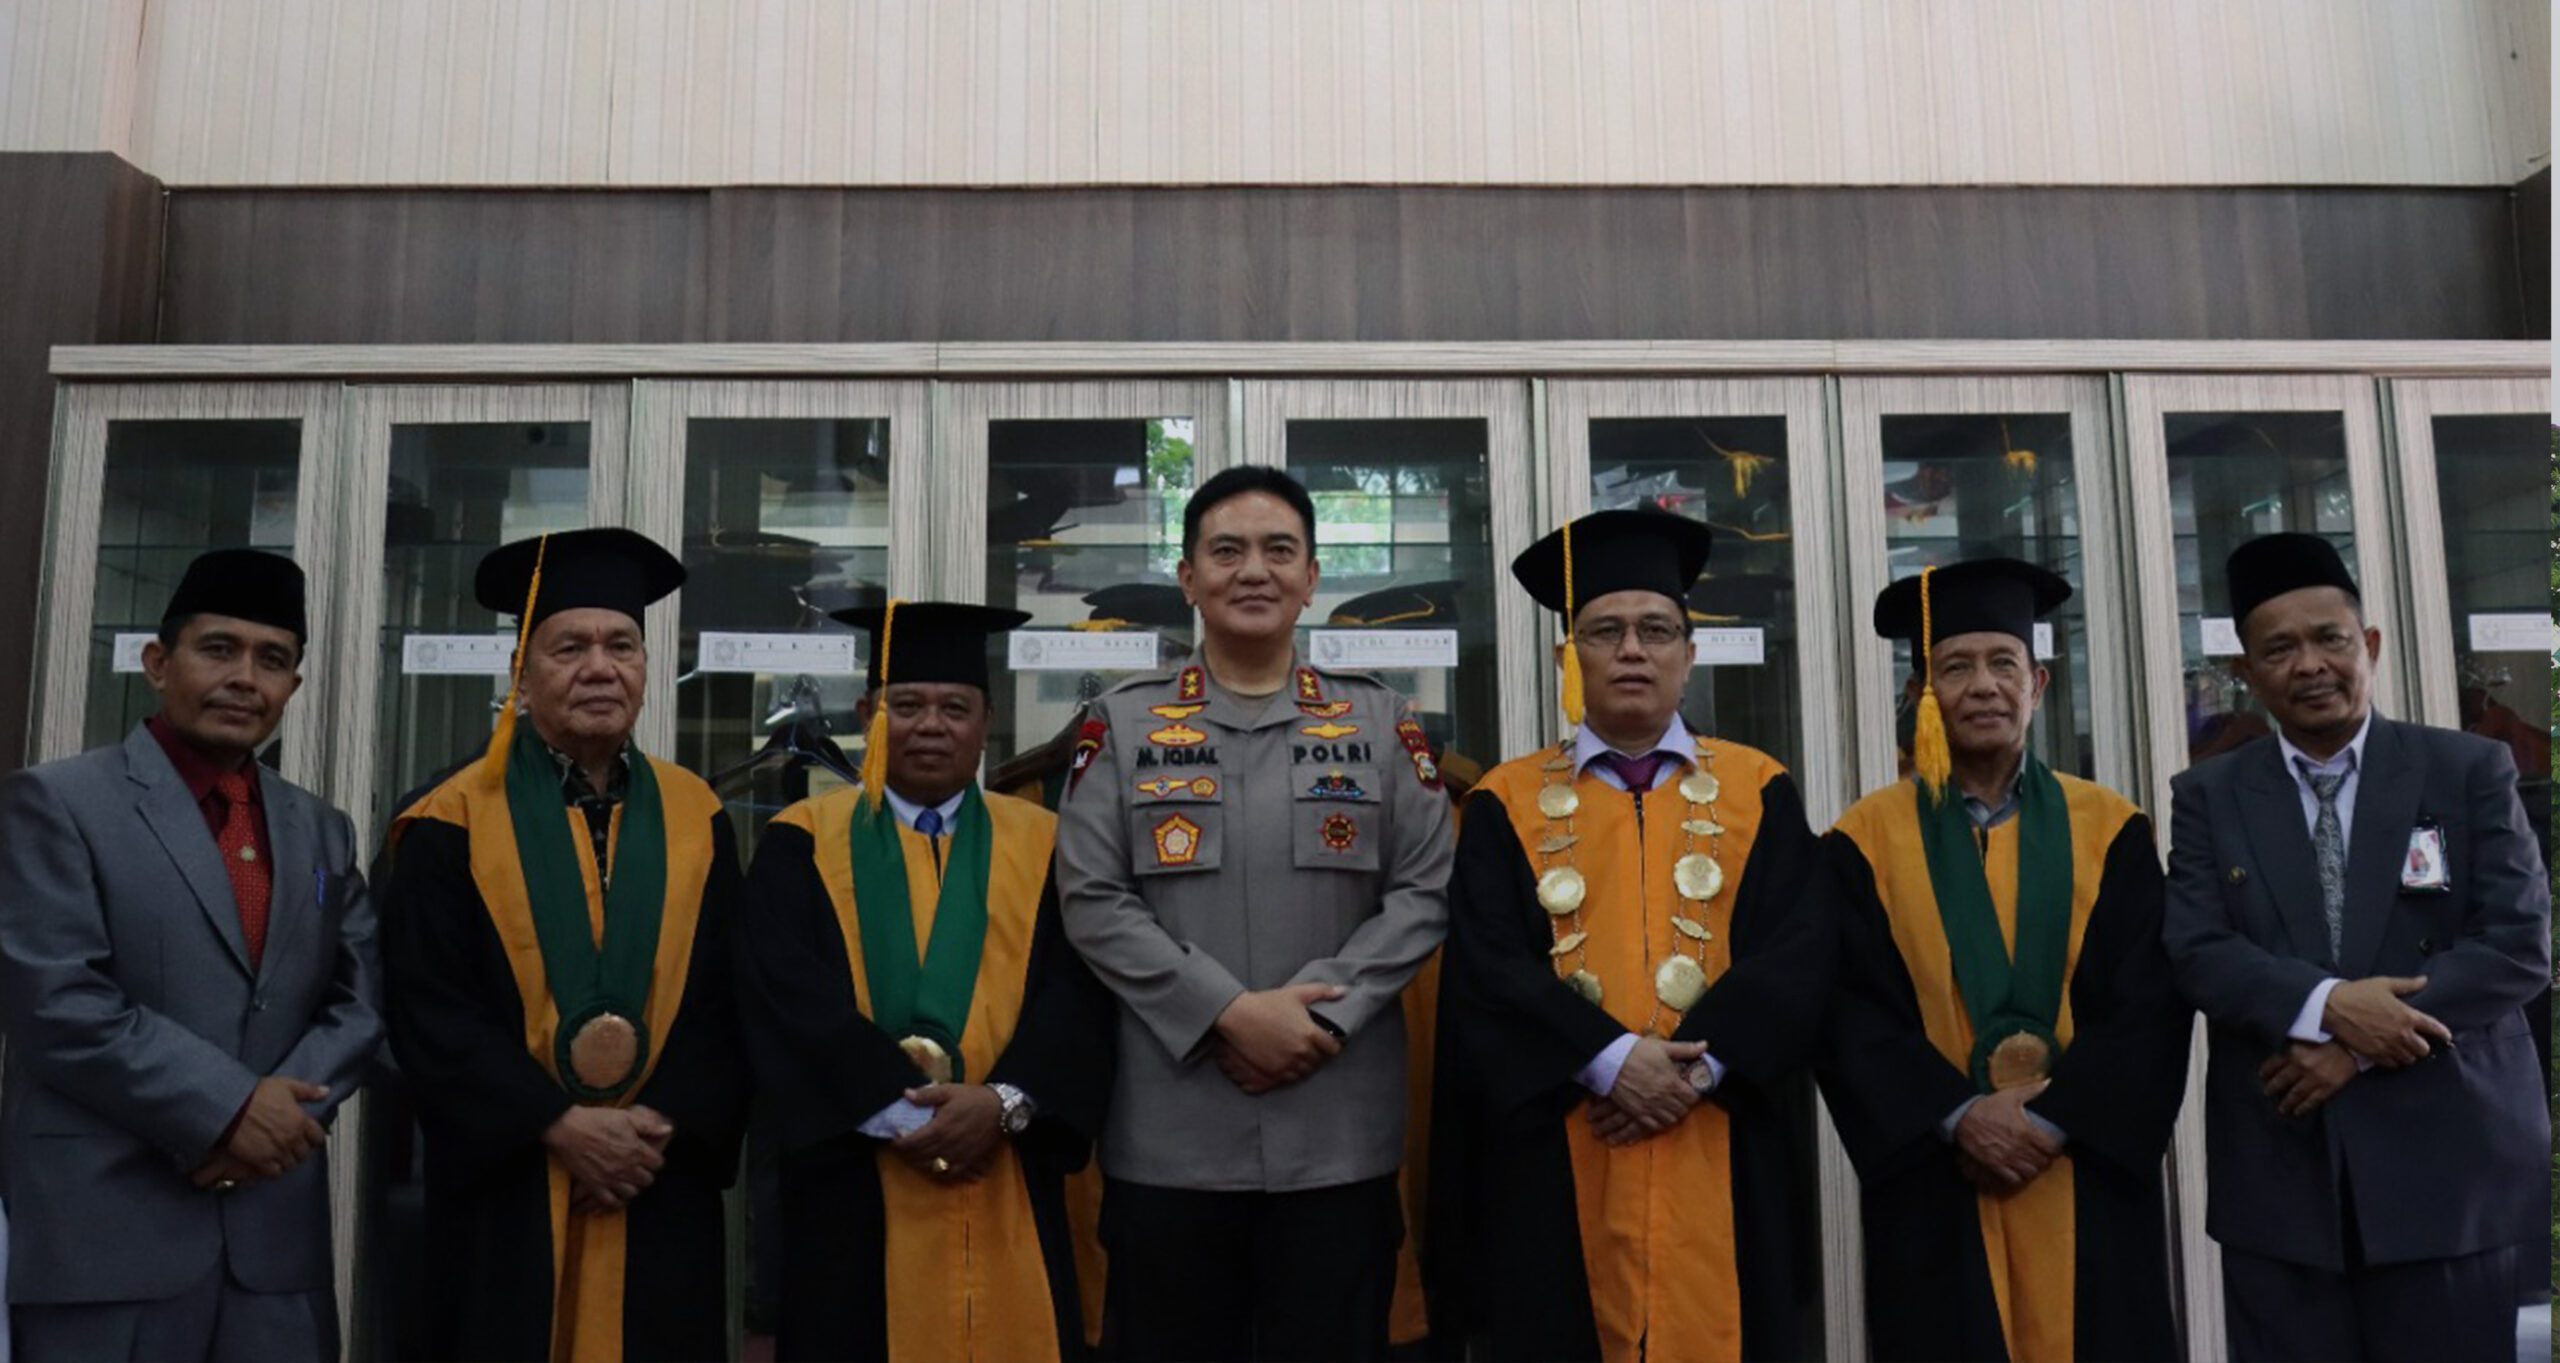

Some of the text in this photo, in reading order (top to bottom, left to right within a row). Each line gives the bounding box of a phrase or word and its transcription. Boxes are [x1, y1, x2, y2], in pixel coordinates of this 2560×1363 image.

[1136, 747, 1219, 767] M. IQBAL
[1293, 743, 1372, 764] POLRI
